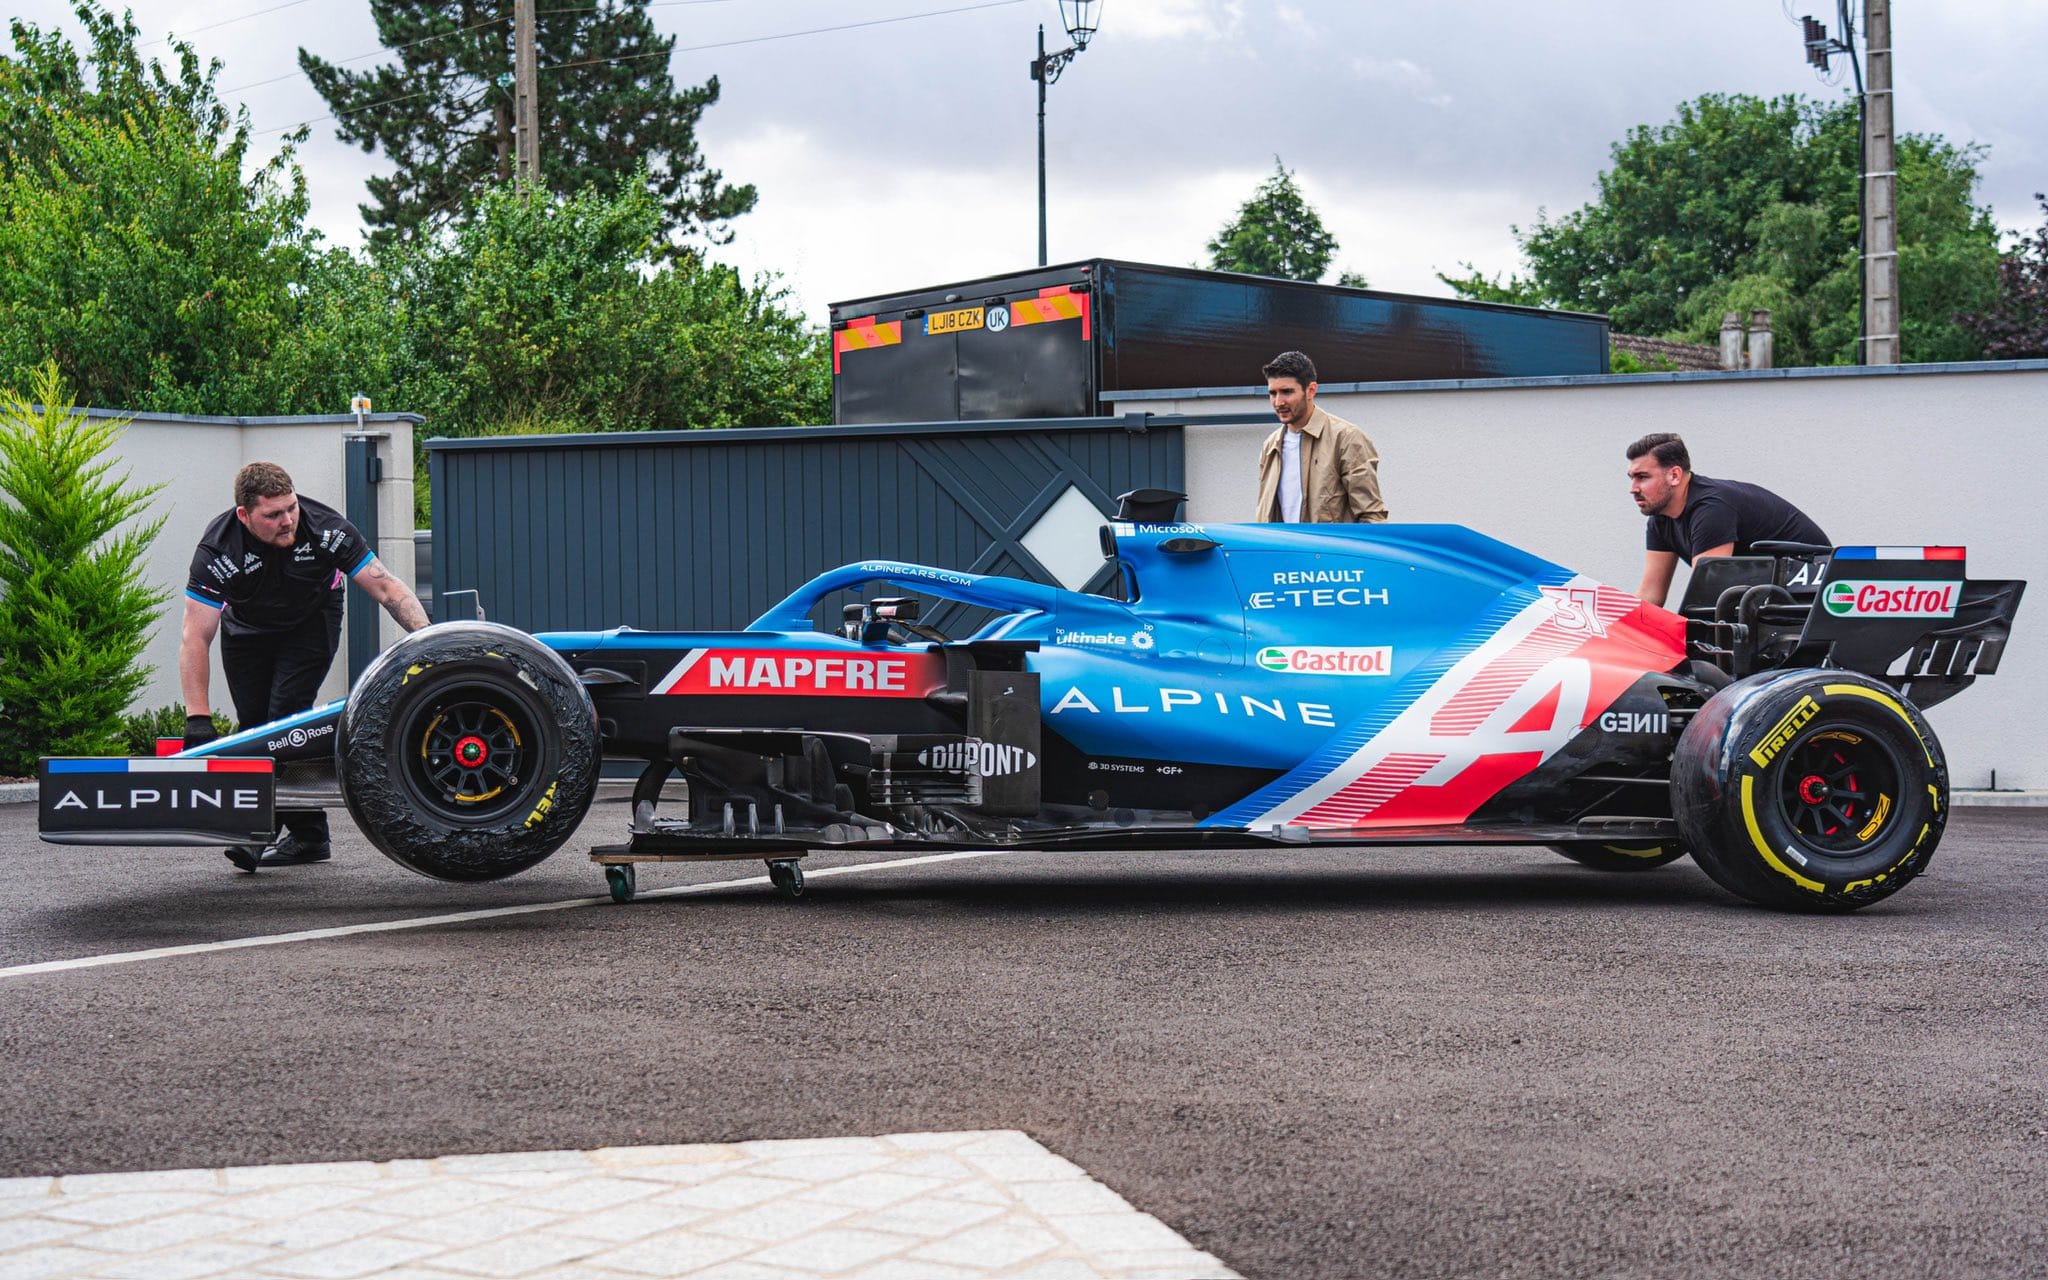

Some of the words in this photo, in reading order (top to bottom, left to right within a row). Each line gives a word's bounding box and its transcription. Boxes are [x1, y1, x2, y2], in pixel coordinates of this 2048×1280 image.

[932, 313, 955, 330] LJ18
[959, 310, 980, 326] CZK
[990, 311, 1005, 328] UK
[1139, 524, 1206, 534] Microsoft
[860, 564, 971, 587] ALPINECARS.COM
[1273, 570, 1364, 585] RENAULT
[1249, 588, 1390, 609] E-TECH
[1856, 584, 1952, 613] Castrol
[1143, 623, 1154, 632] bp
[1056, 632, 1127, 645] ultimate
[1291, 649, 1384, 672] Castrol
[709, 657, 905, 691] MAPFRE
[1050, 685, 1336, 728] ALPINE
[267, 737, 289, 751] Bell
[291, 730, 306, 745] &
[307, 724, 334, 739] Ross
[1749, 695, 1821, 768] PIRELLI
[932, 742, 1024, 777] DUPONT
[1111, 764, 1145, 773] SYSTEMS
[53, 789, 259, 810] ALPINE
